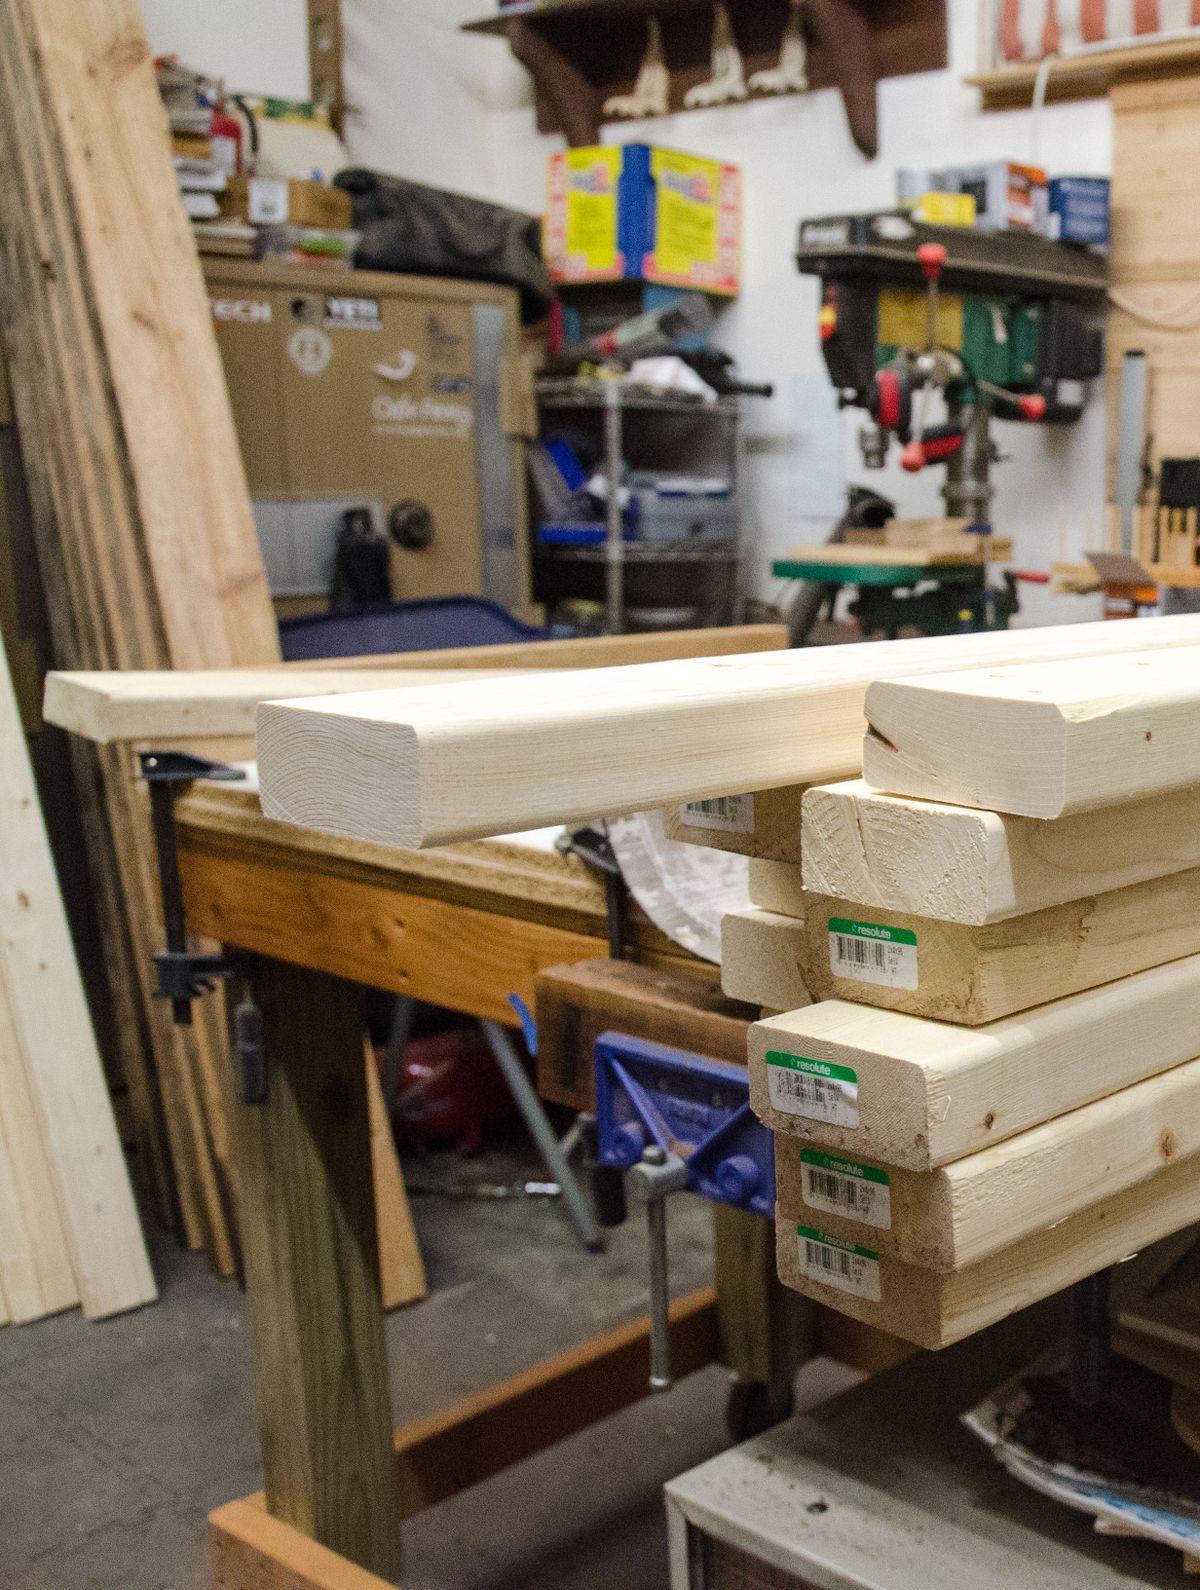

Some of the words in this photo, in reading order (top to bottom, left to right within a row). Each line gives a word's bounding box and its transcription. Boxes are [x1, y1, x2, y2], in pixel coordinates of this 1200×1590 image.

[208, 299, 272, 322] ECH
[857, 926, 891, 939] resolute
[796, 1060, 831, 1075] resolute
[830, 1160, 864, 1177] resolute
